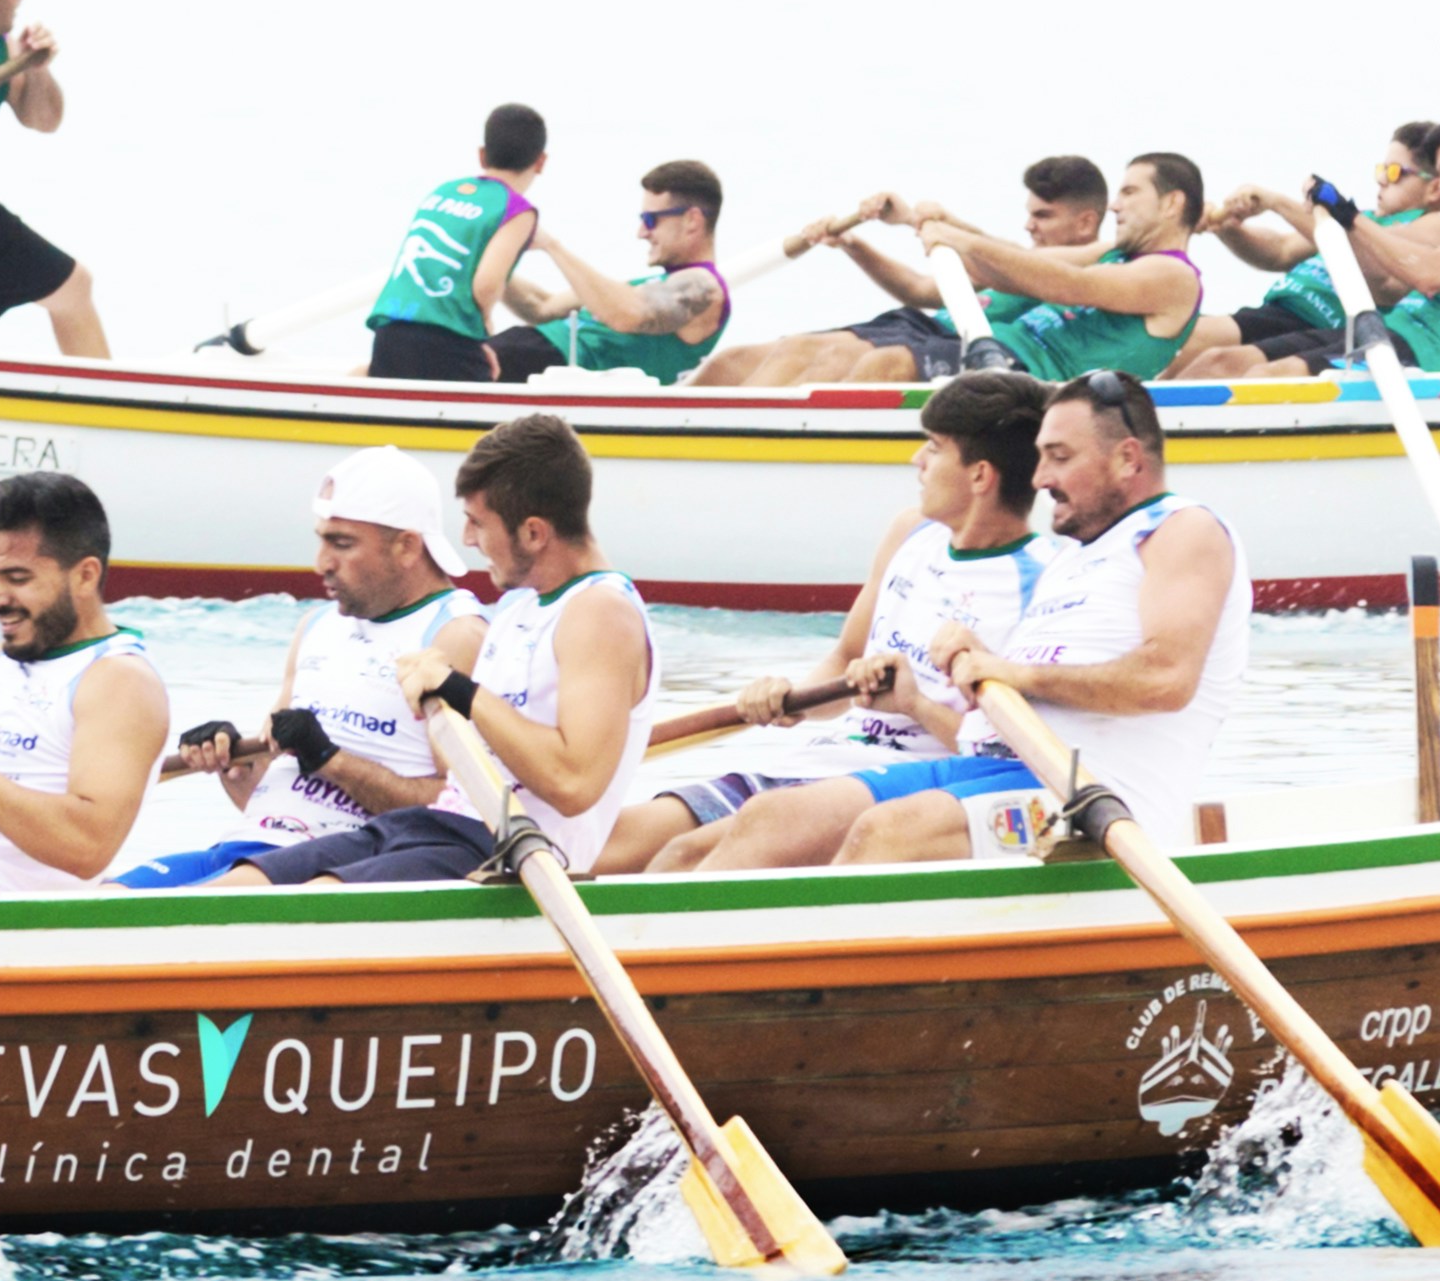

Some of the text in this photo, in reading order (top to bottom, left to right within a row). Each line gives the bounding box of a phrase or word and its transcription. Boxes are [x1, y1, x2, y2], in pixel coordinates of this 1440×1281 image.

[1126, 999, 1163, 1050] CLUB
[1163, 979, 1187, 1004] DE
[1360, 1003, 1432, 1049] crpp
[263, 1028, 597, 1117] QUEIPO
[226, 1133, 433, 1180] dental
